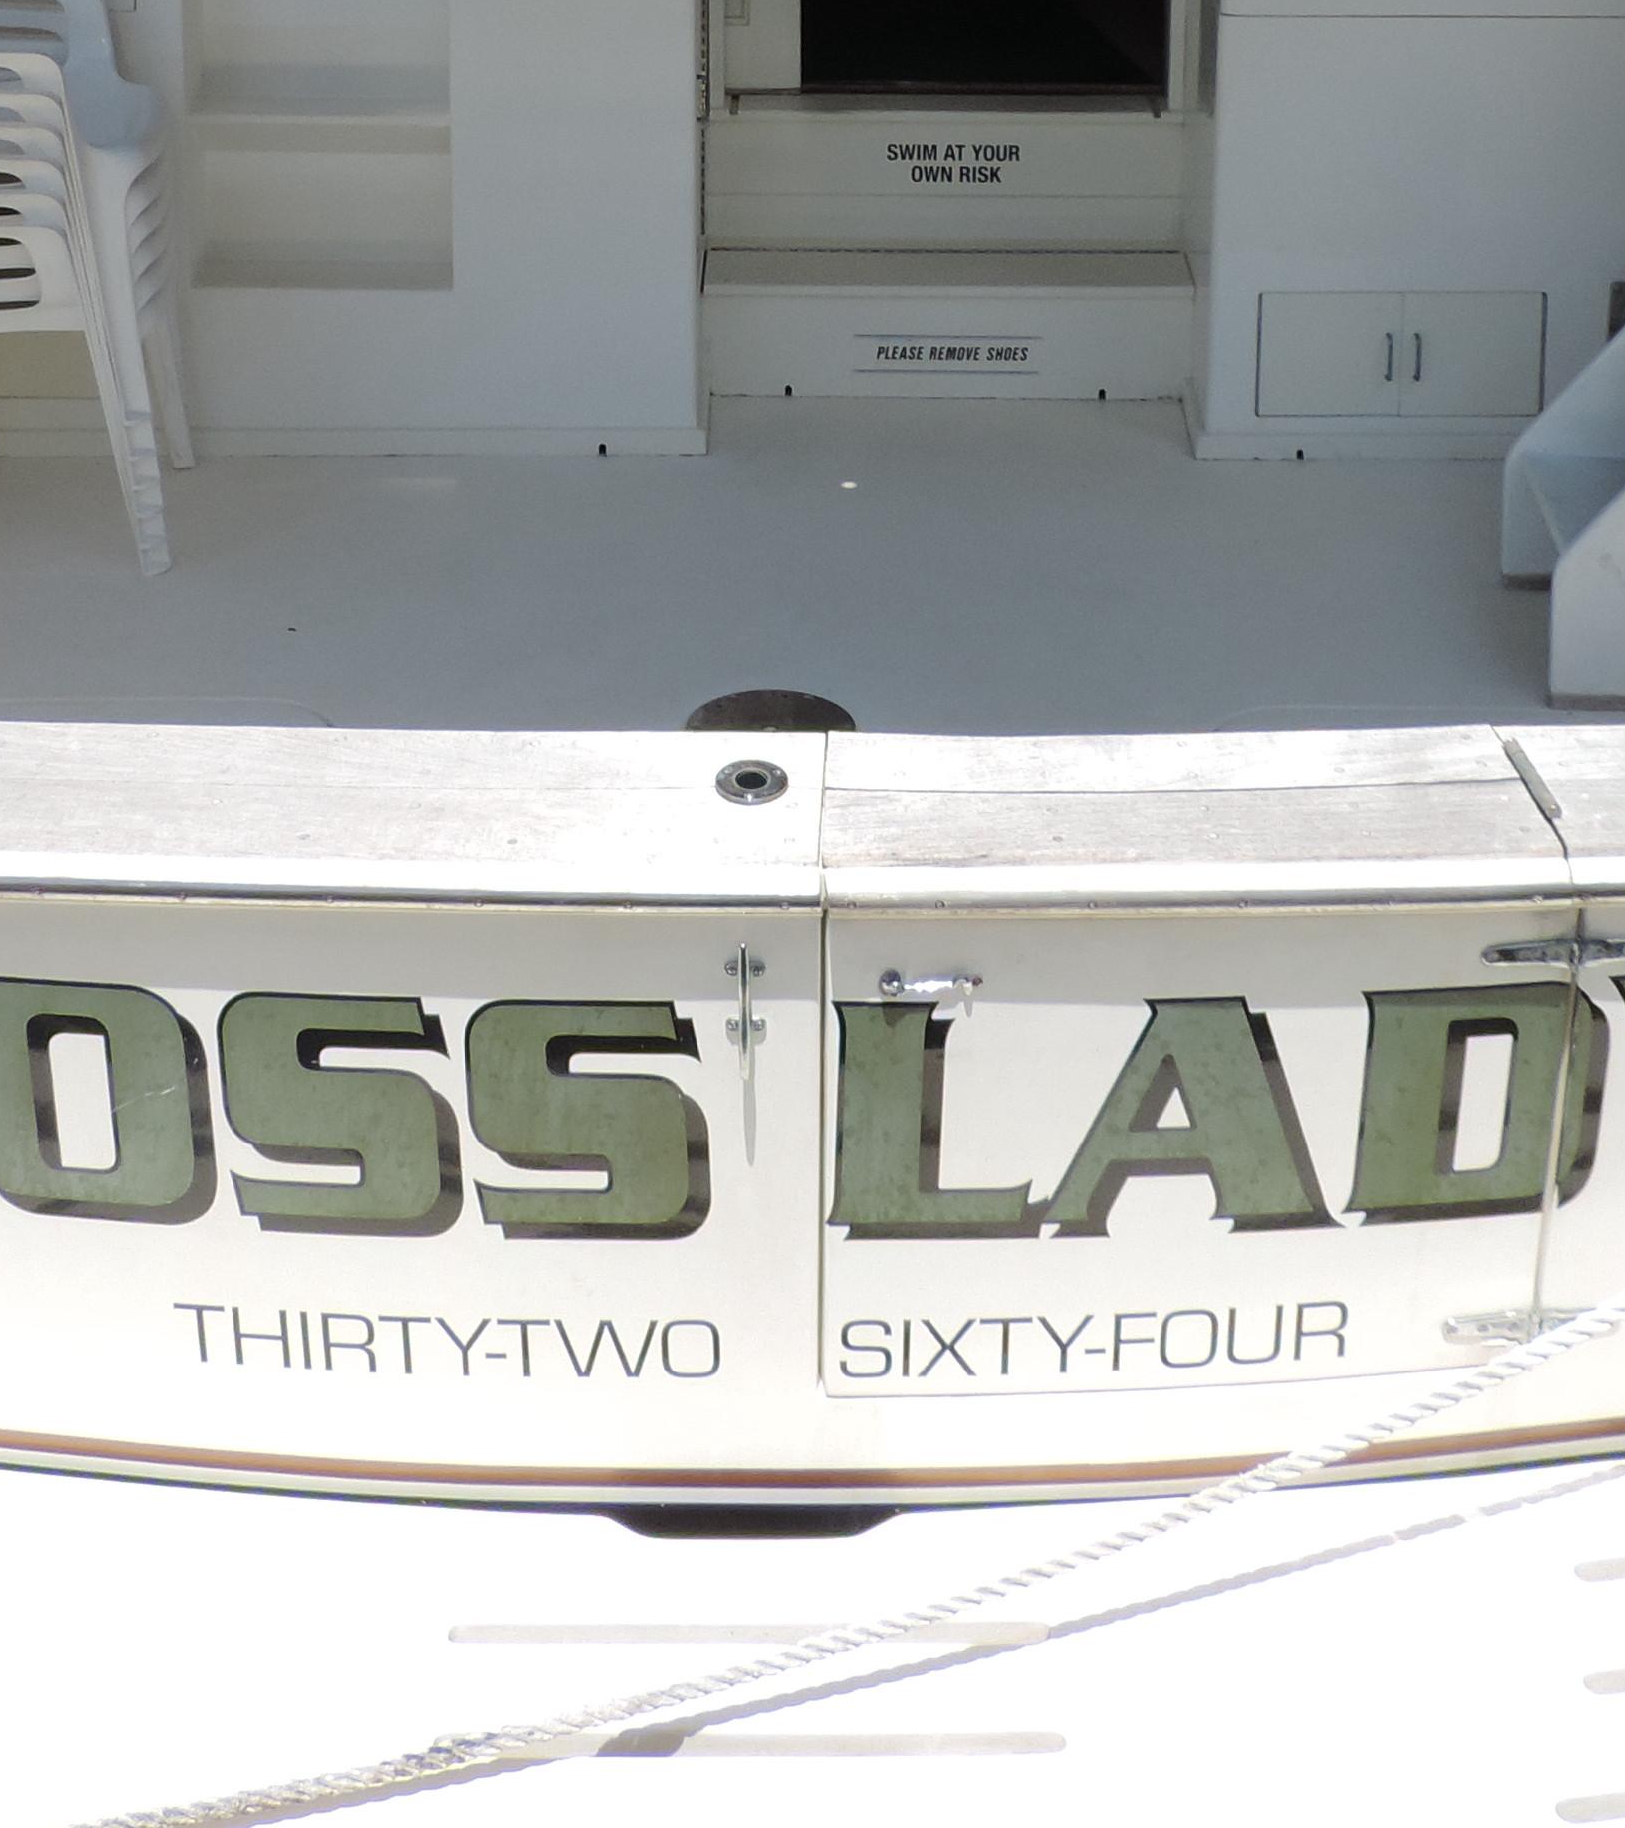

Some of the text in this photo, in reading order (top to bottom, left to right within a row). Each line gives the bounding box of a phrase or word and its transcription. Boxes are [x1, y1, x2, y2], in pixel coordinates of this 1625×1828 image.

[886, 143, 1021, 162] SWIM AT YOUR
[911, 165, 1002, 183] OWN RISK
[876, 346, 1029, 362] PLEASE REMOVE SHOES
[173, 1301, 1350, 1380] THIRTY-TWO SIXTY-FOUR
